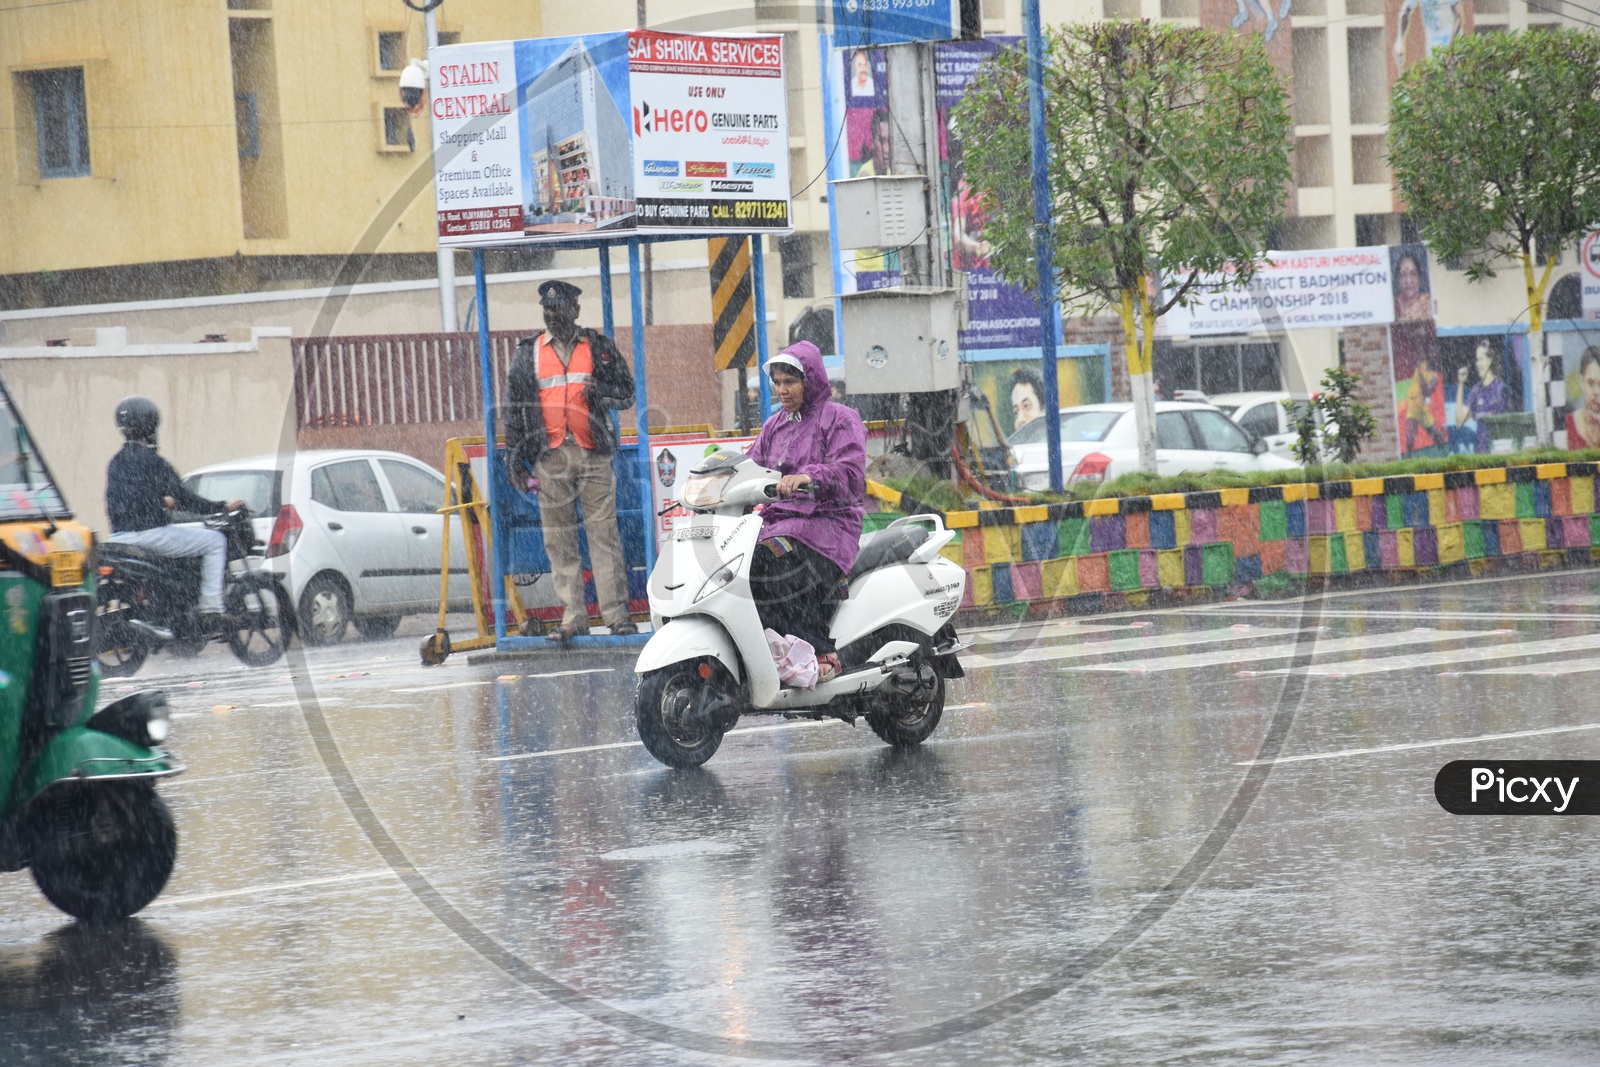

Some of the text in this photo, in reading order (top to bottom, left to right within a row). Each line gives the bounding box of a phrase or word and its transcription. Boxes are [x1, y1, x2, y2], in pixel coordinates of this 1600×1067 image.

[628, 37, 779, 65] SAI SHRIKA SERVICES
[440, 61, 499, 88] STALIN
[688, 86, 726, 99] USE ONLY
[433, 93, 511, 119] CENTRAL
[654, 108, 778, 133] Hero GENUINE PARTS
[440, 126, 507, 147] Shopping Mall
[471, 150, 478, 162] &
[439, 164, 511, 182] Premium Office
[439, 182, 513, 203] Spaces Available
[645, 205, 658, 217] BUY
[659, 205, 689, 217] GENUINE
[690, 205, 709, 217] PARTS
[735, 201, 787, 219] 8297112341
[1291, 256, 1330, 270] KASTURI
[1332, 253, 1381, 267] MEMORIAL
[1299, 271, 1387, 289] BADMINTON
[1210, 291, 1349, 312] CHAMPIONSHIP 2018
[720, 519, 748, 550] MAESTRO
